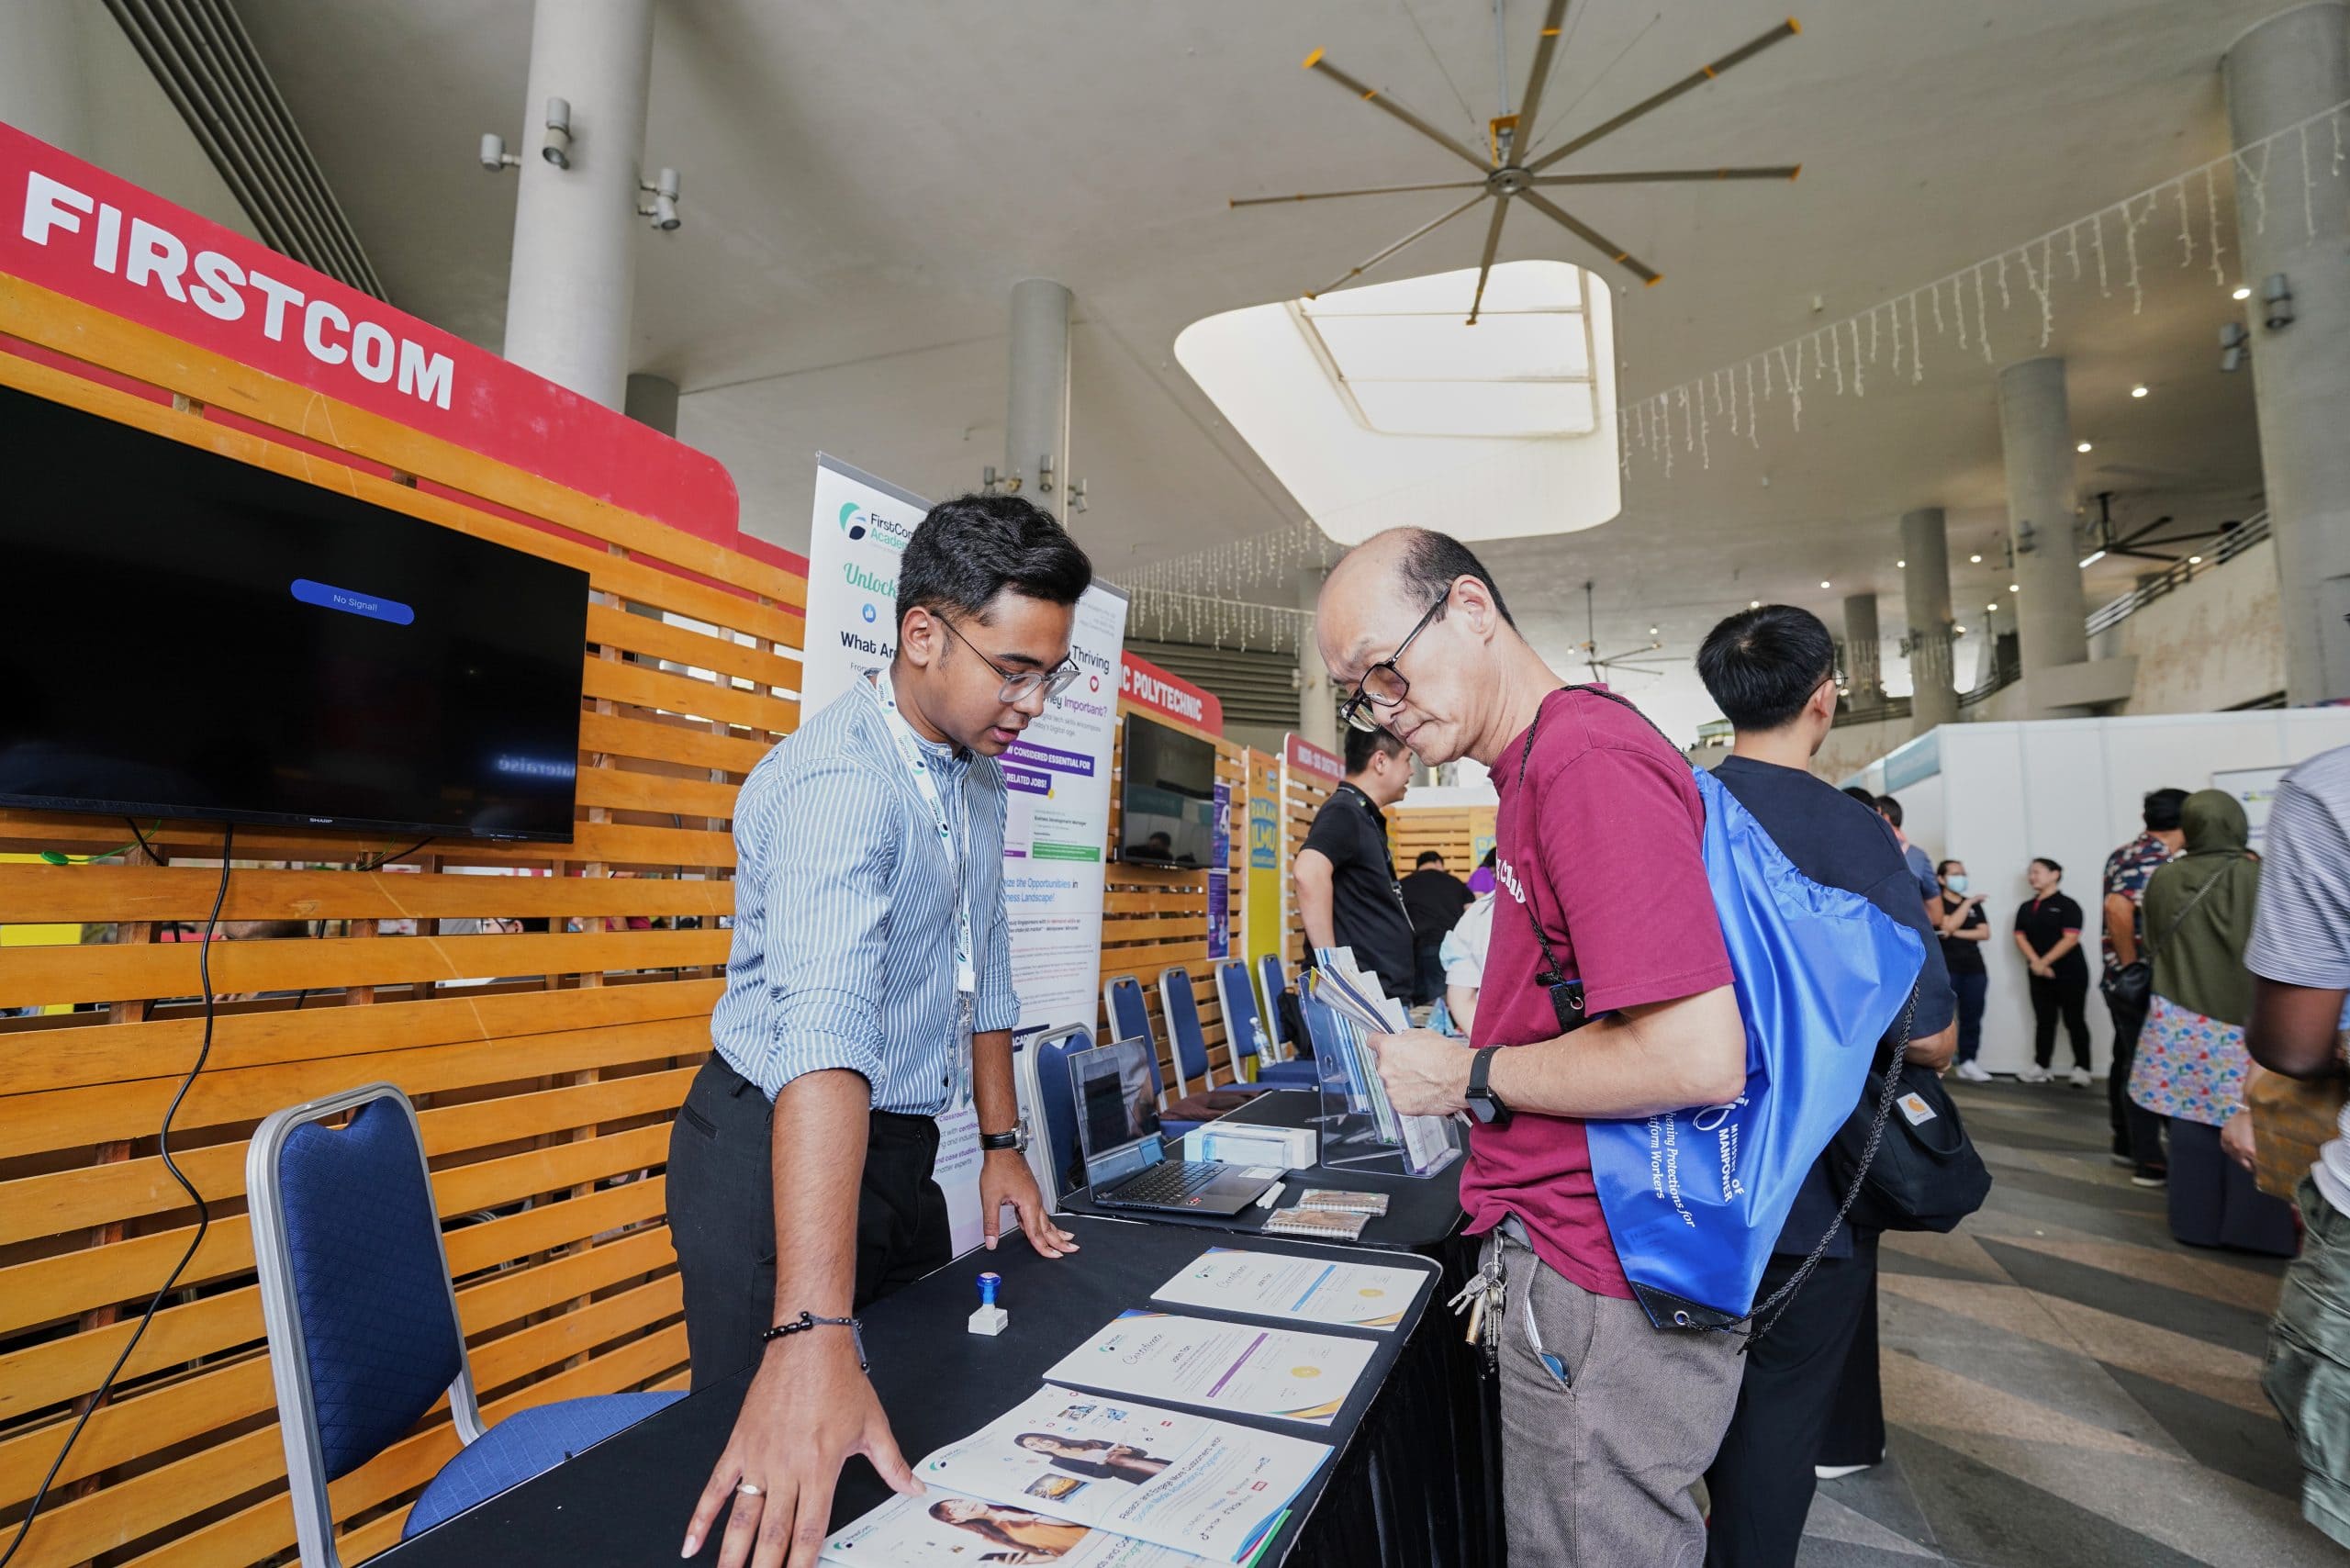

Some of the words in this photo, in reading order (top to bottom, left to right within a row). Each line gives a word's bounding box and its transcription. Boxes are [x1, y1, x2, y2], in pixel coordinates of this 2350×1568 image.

[22, 171, 454, 410] FIRSTCOM
[333, 594, 346, 604] No
[349, 598, 377, 612] Signal!
[841, 631, 877, 655] What
[1072, 644, 1110, 675] Thriving
[1065, 696, 1108, 717] Important?
[1133, 669, 1203, 722] POLYTECHNIC
[1014, 746, 1048, 763] CONSIDERED
[1048, 755, 1079, 767] ESSENTIAL
[1079, 761, 1091, 770] FOR
[1007, 773, 1030, 785] RELATED
[1030, 778, 1047, 789] JOBS!
[1500, 859, 1527, 903] Club
[1718, 1128, 1733, 1203] MANPOWER
[1730, 1124, 1739, 1171] MINISTRY
[1651, 1150, 1665, 1199] Workers
[1667, 1148, 1684, 1208] Protections
[1676, 1208, 1695, 1227] for
[1731, 1179, 1744, 1195] OF
